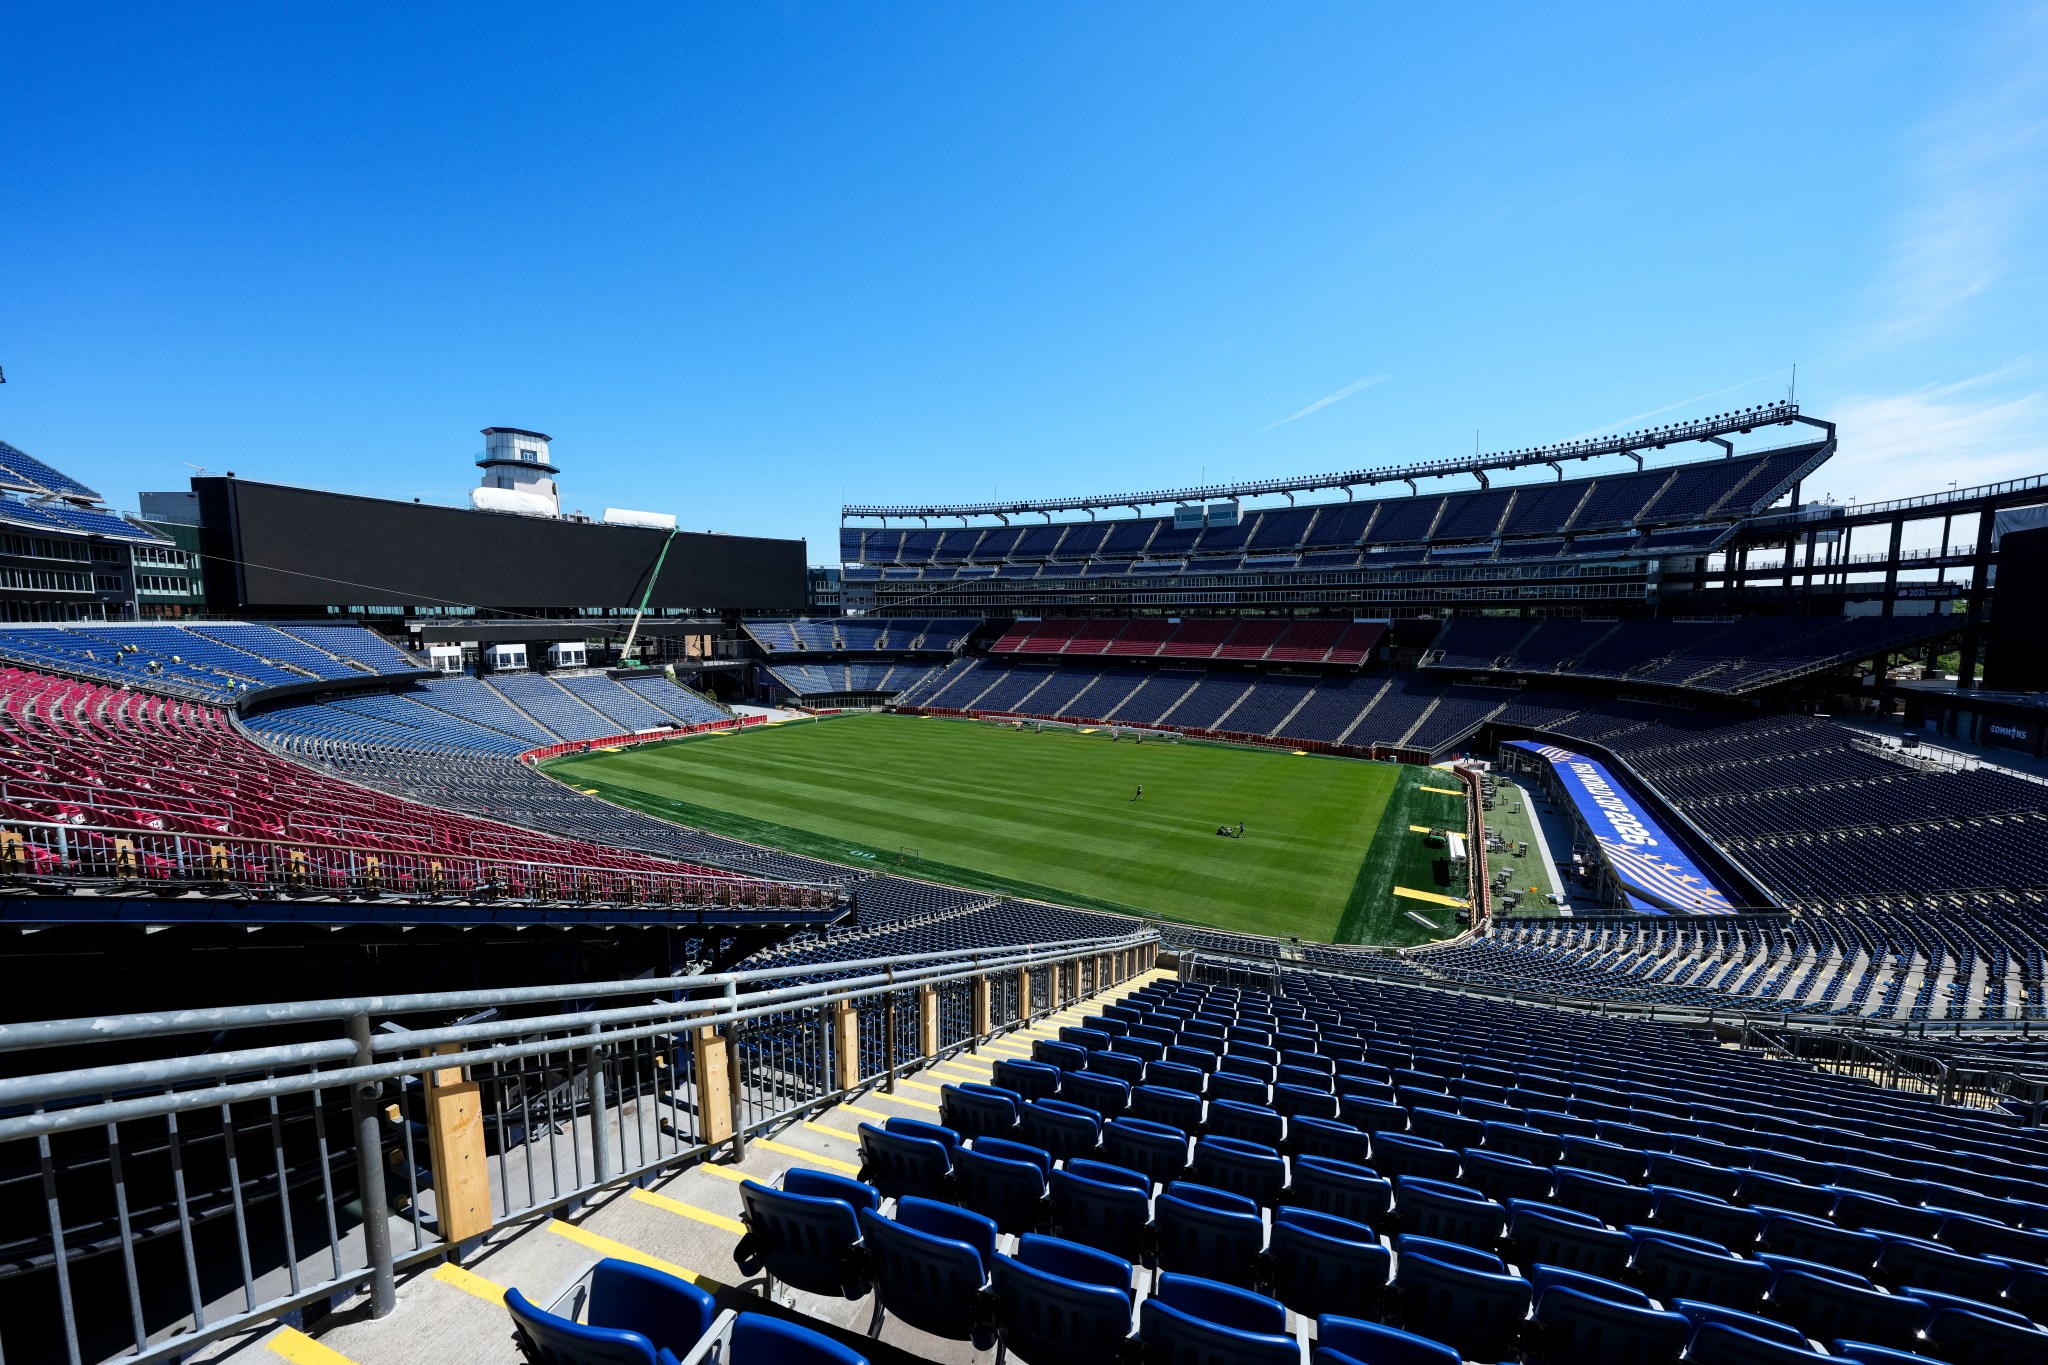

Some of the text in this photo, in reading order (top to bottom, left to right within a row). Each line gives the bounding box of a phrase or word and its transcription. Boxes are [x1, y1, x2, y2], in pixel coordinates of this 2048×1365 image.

[1909, 589, 1926, 597] 2021
[1568, 762, 1658, 846] FIFA WORLD CUP 2026
